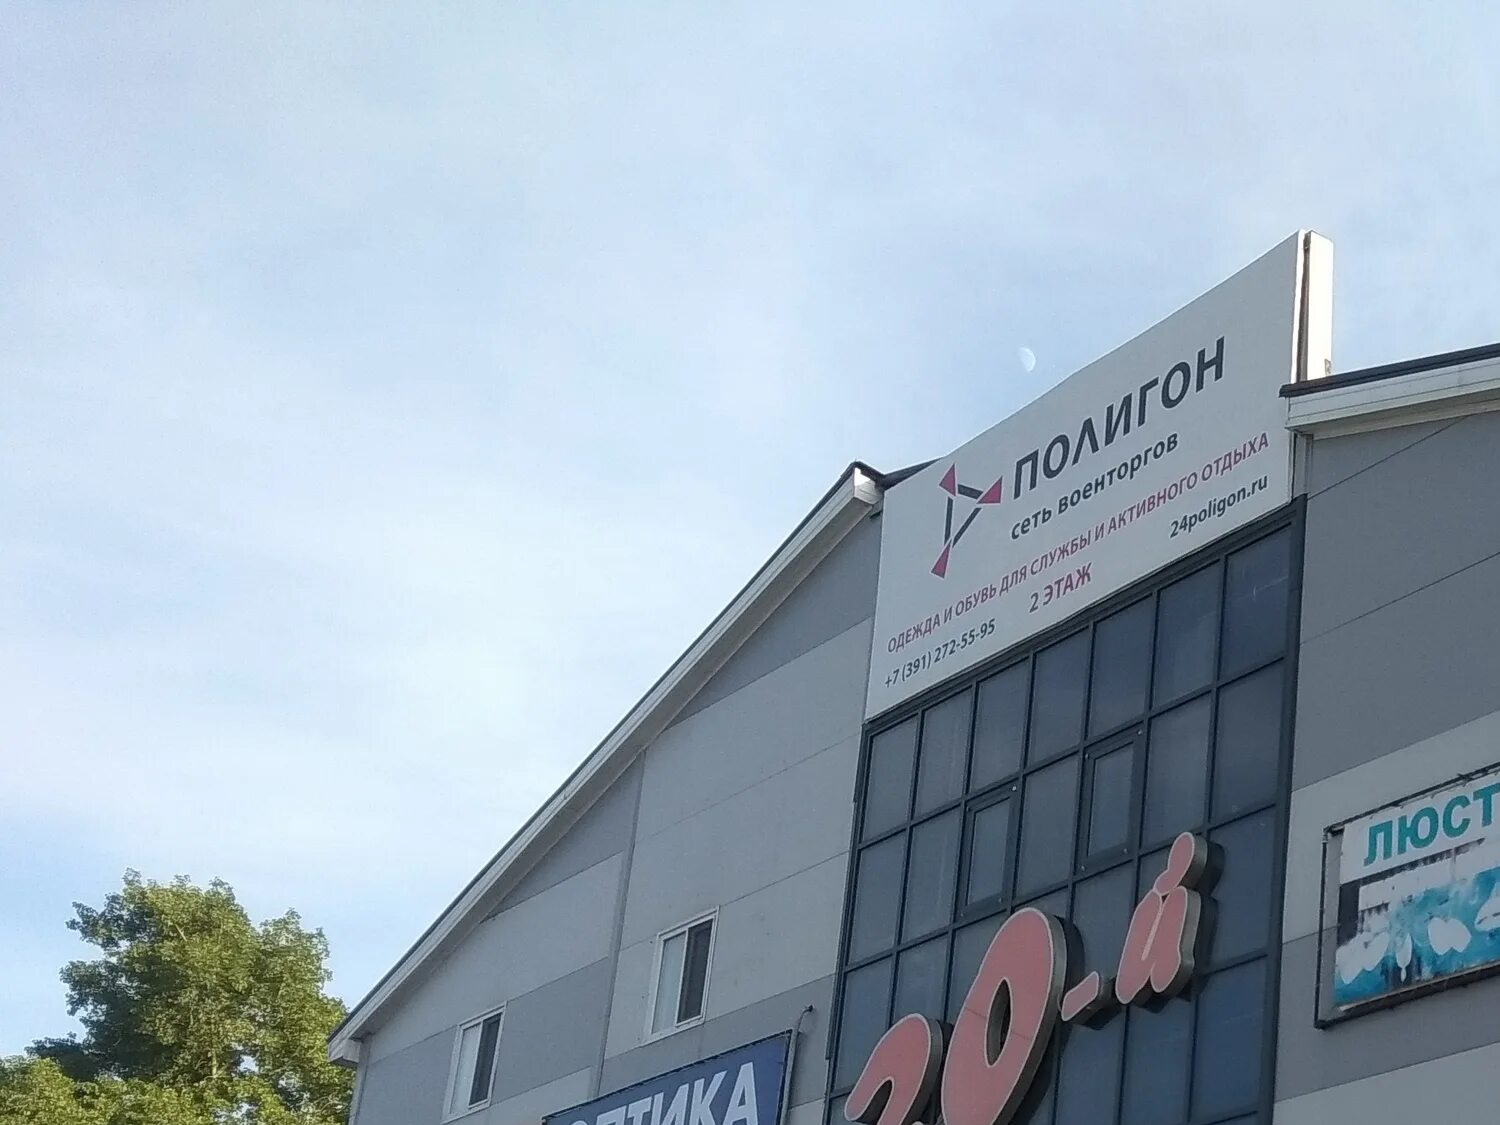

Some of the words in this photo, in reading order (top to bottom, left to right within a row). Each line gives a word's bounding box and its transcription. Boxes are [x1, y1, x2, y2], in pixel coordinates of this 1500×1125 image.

[1013, 336, 1225, 500] ПОЛИГОН
[1011, 507, 1052, 540] сеть
[1058, 433, 1178, 516] военторгов
[1170, 475, 1268, 539] 24poligon.ru
[888, 614, 940, 653] ОДЕЖДА
[943, 604, 953, 625] И
[955, 583, 997, 616] ОБУВЬ
[999, 564, 1028, 596] ДЛЯ
[1030, 530, 1091, 580] СЛУЖБЫ
[1094, 523, 1105, 543] И
[1108, 470, 1198, 537] АКТИВНОГО
[1201, 432, 1269, 483] ОТДЫХА
[1029, 592, 1039, 613] 2
[1043, 563, 1092, 607] ЭТАЖ
[884, 669, 900, 688] +7
[902, 651, 932, 682] (391)
[935, 618, 996, 664] 272-55-95
